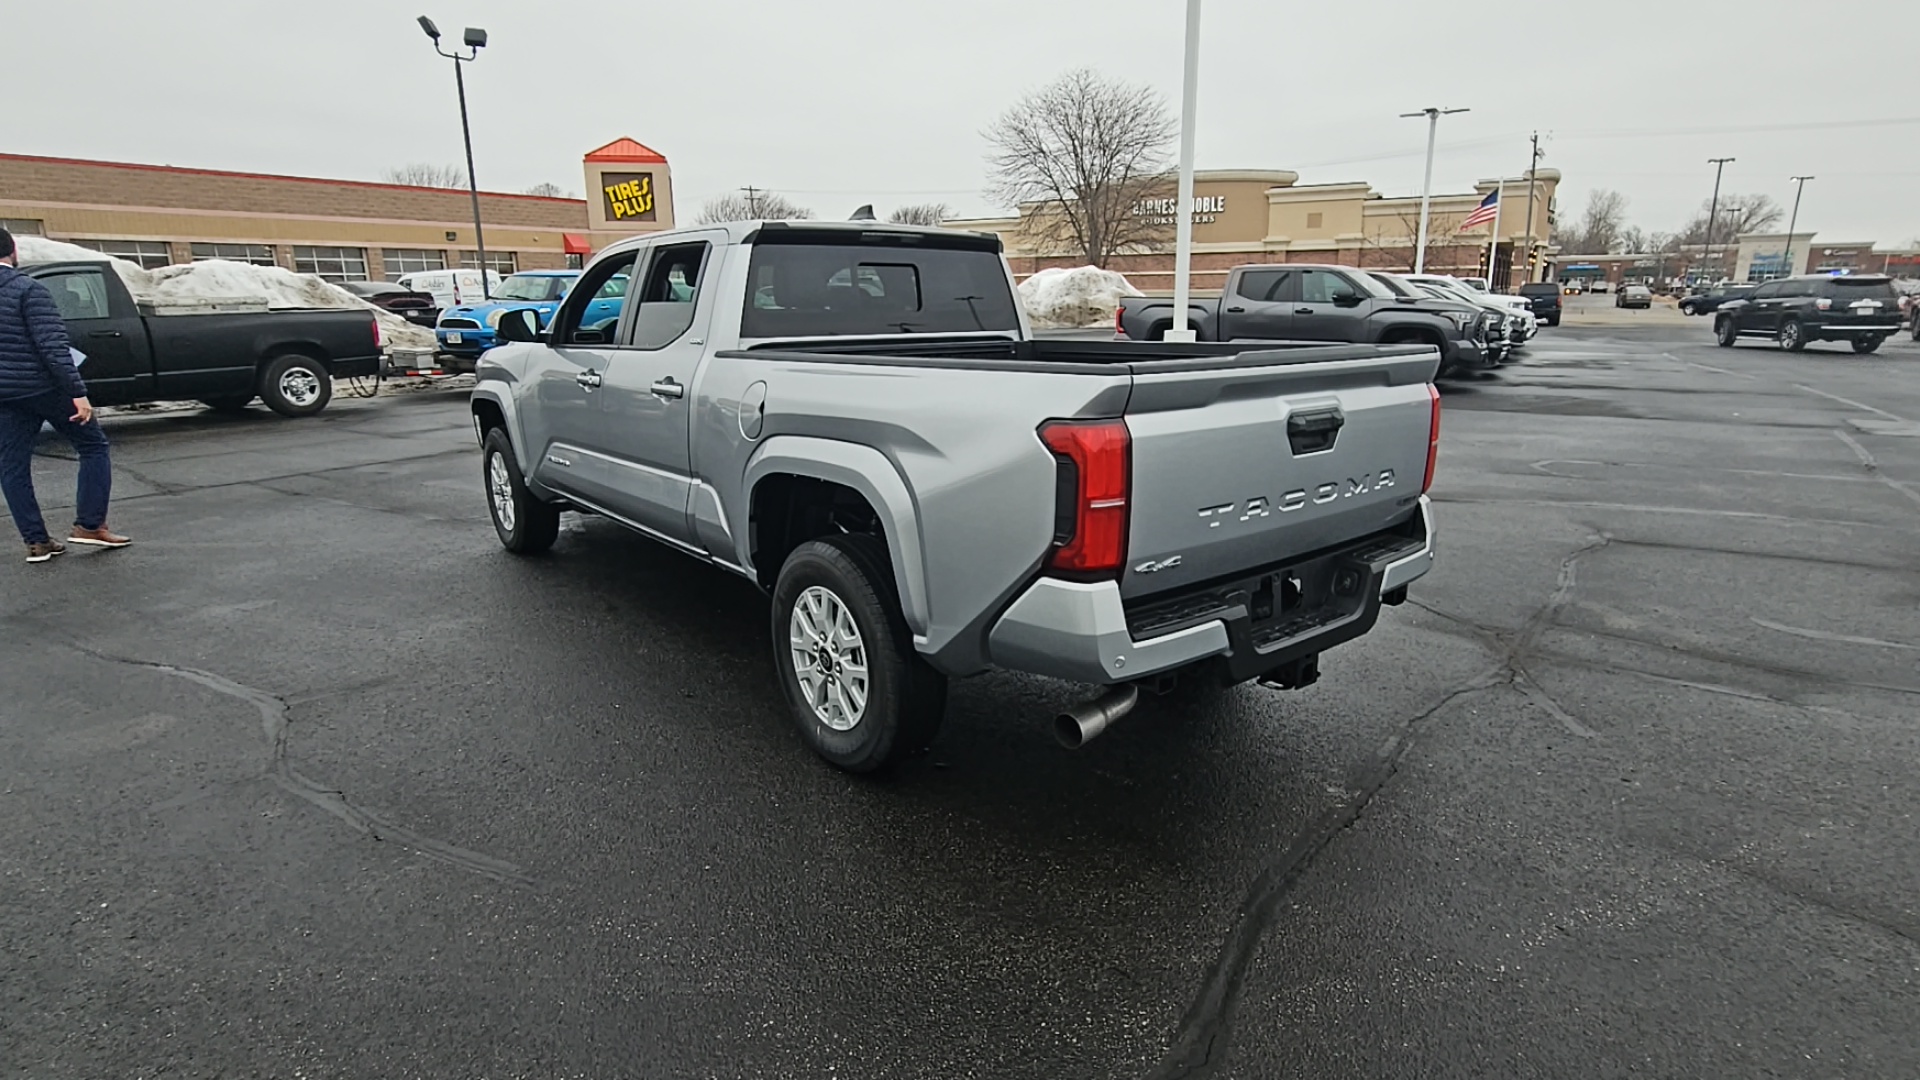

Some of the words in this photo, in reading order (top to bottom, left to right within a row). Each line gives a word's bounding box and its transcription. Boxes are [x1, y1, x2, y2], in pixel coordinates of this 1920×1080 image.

[605, 176, 649, 203] TIRES
[612, 193, 652, 219] PLUS
[1198, 468, 1395, 527] TACOMA
